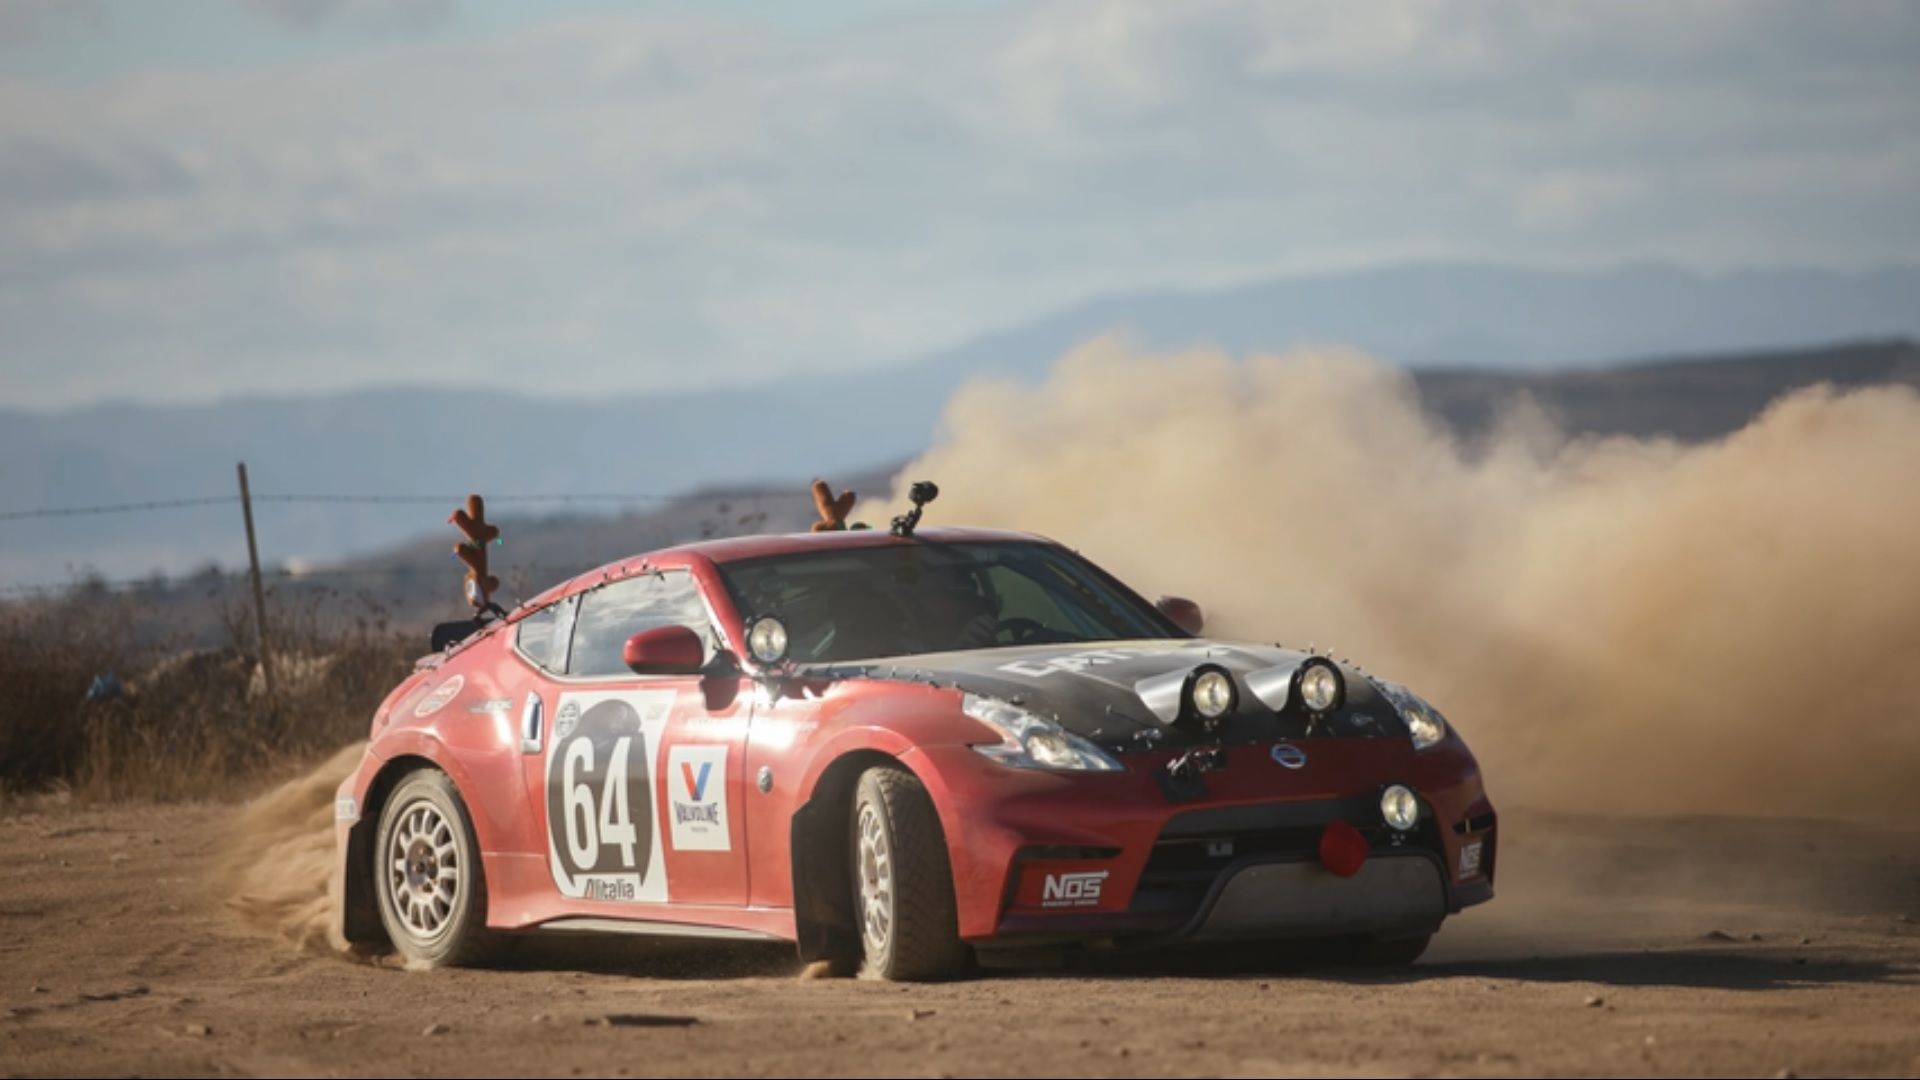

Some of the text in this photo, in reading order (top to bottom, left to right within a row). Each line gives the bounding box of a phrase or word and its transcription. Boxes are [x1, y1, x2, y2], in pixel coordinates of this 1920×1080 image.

[564, 737, 637, 870] 64
[584, 879, 635, 900] Alitalia
[1043, 870, 1109, 898] NOS
